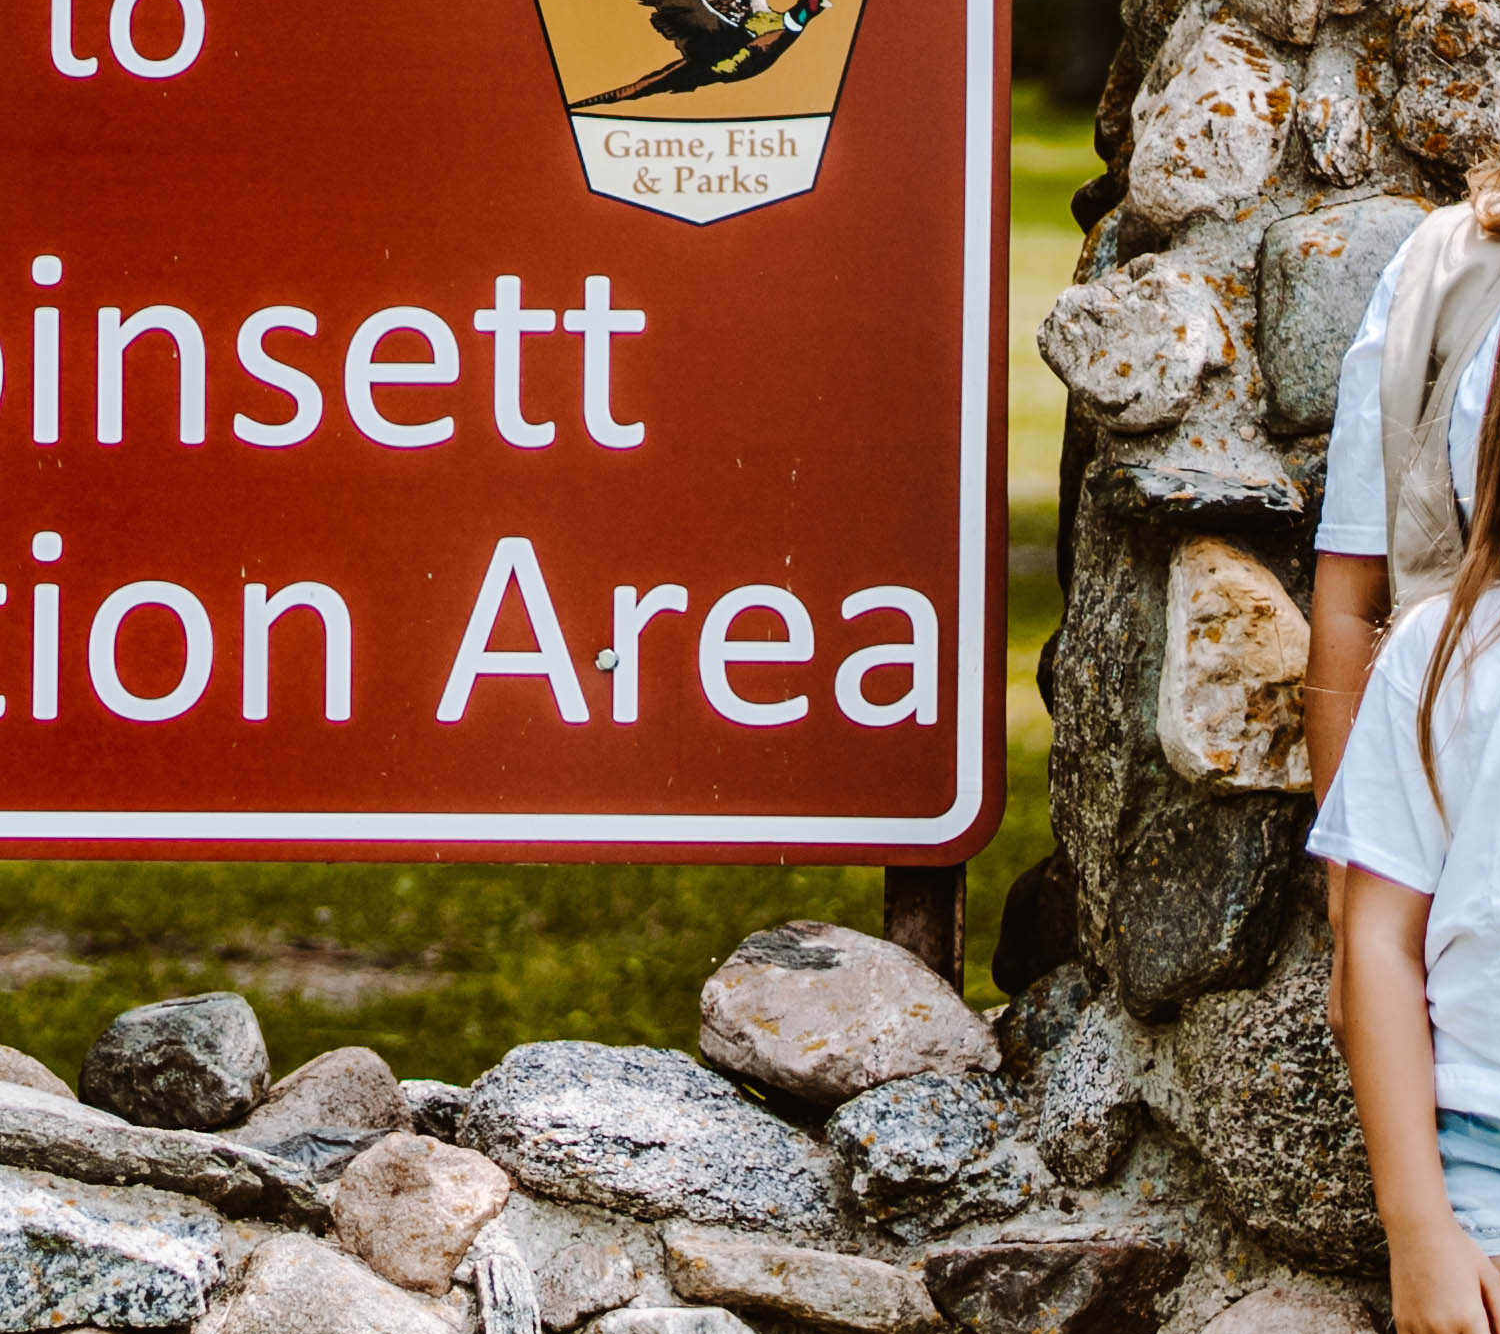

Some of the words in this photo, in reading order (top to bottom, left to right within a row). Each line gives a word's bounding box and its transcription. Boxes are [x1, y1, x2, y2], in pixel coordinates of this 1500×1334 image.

[604, 129, 714, 162] Game,
[727, 129, 799, 159] Fish
[632, 166, 661, 195] &
[674, 165, 769, 195] Parks
[435, 536, 940, 728] Area
